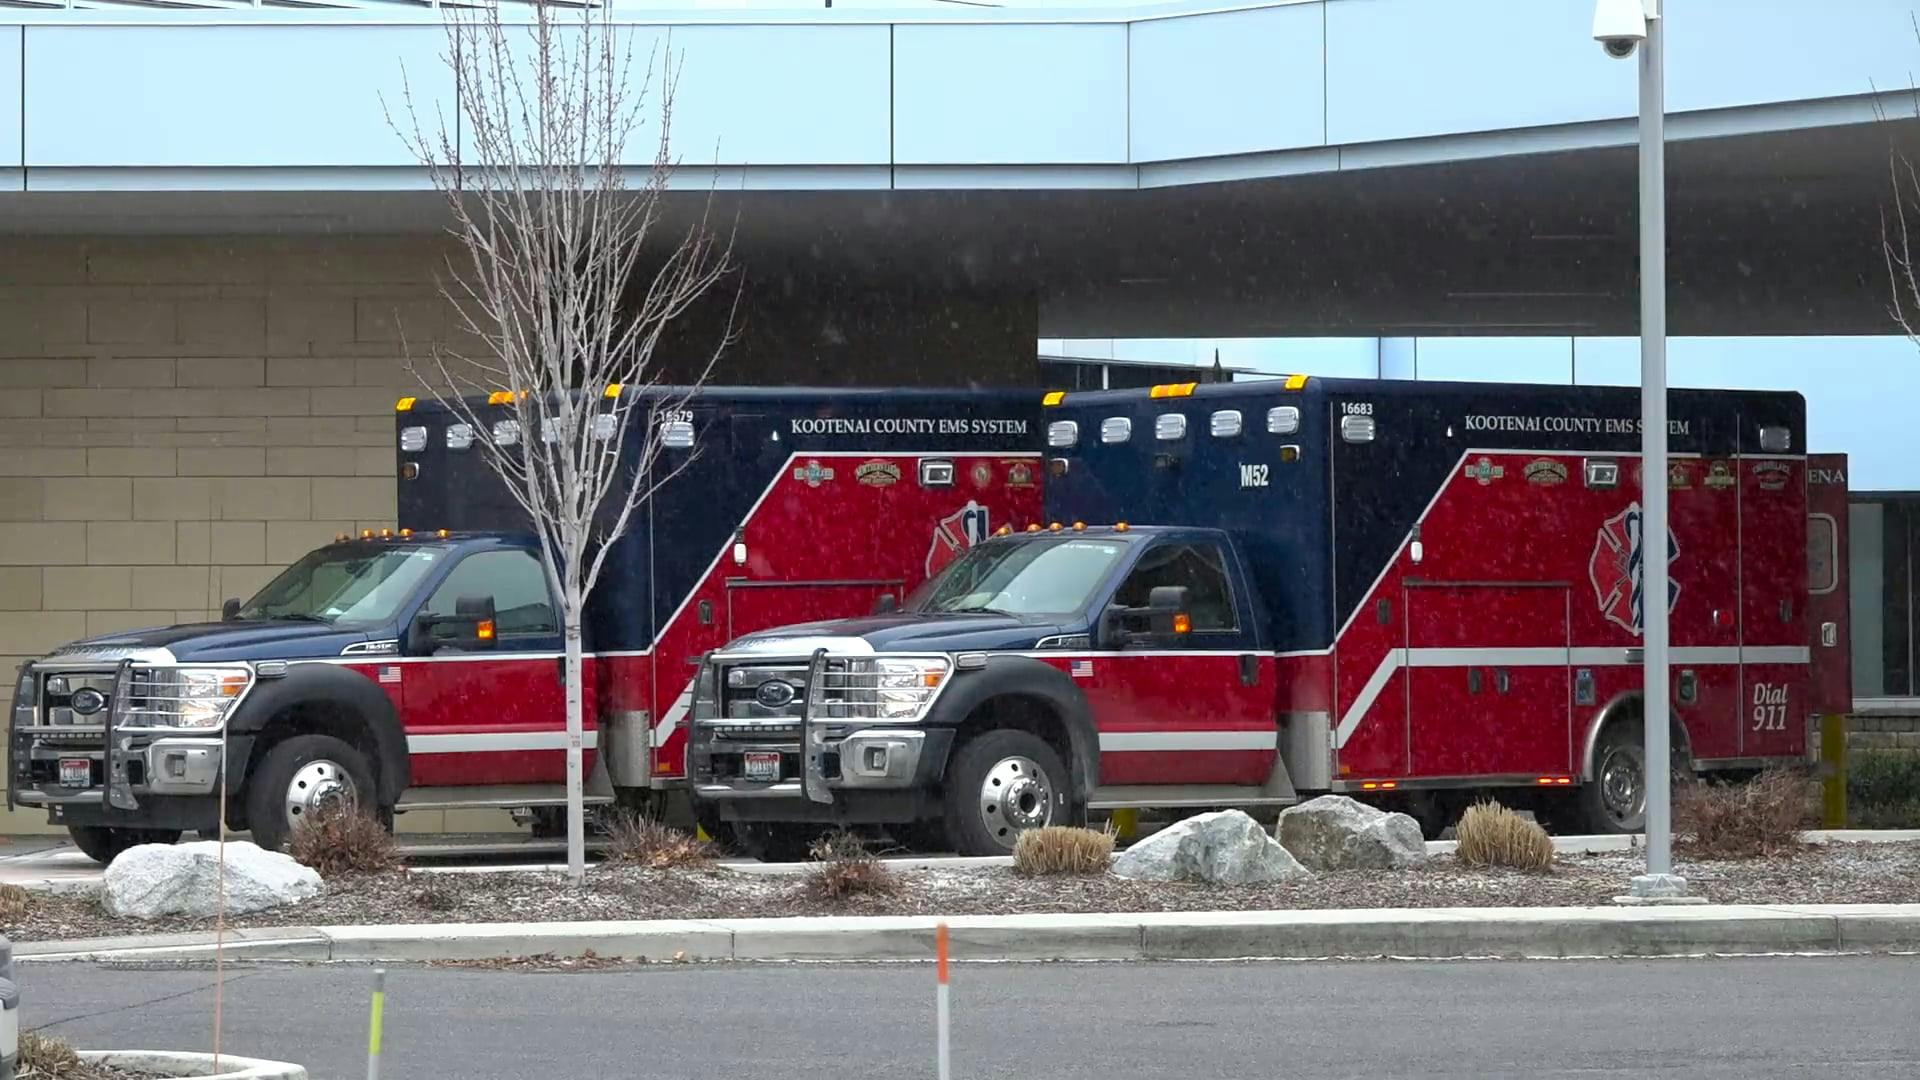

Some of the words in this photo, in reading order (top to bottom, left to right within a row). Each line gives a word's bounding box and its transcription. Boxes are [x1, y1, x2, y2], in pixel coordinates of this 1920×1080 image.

[1341, 402, 1373, 415] 16683
[791, 418, 871, 434] KOOTENAI
[874, 418, 936, 433] COUNTY
[939, 418, 969, 434] EMS
[971, 418, 1028, 434] SYSTEM
[1465, 415, 1541, 431] KOOTENAI
[1543, 416, 1602, 433] COUNTY
[1605, 418, 1634, 434] EMS
[1636, 419, 1689, 435] SEM
[1240, 464, 1269, 488] M52
[1753, 682, 1789, 705] Dial
[1752, 705, 1787, 731] 911
